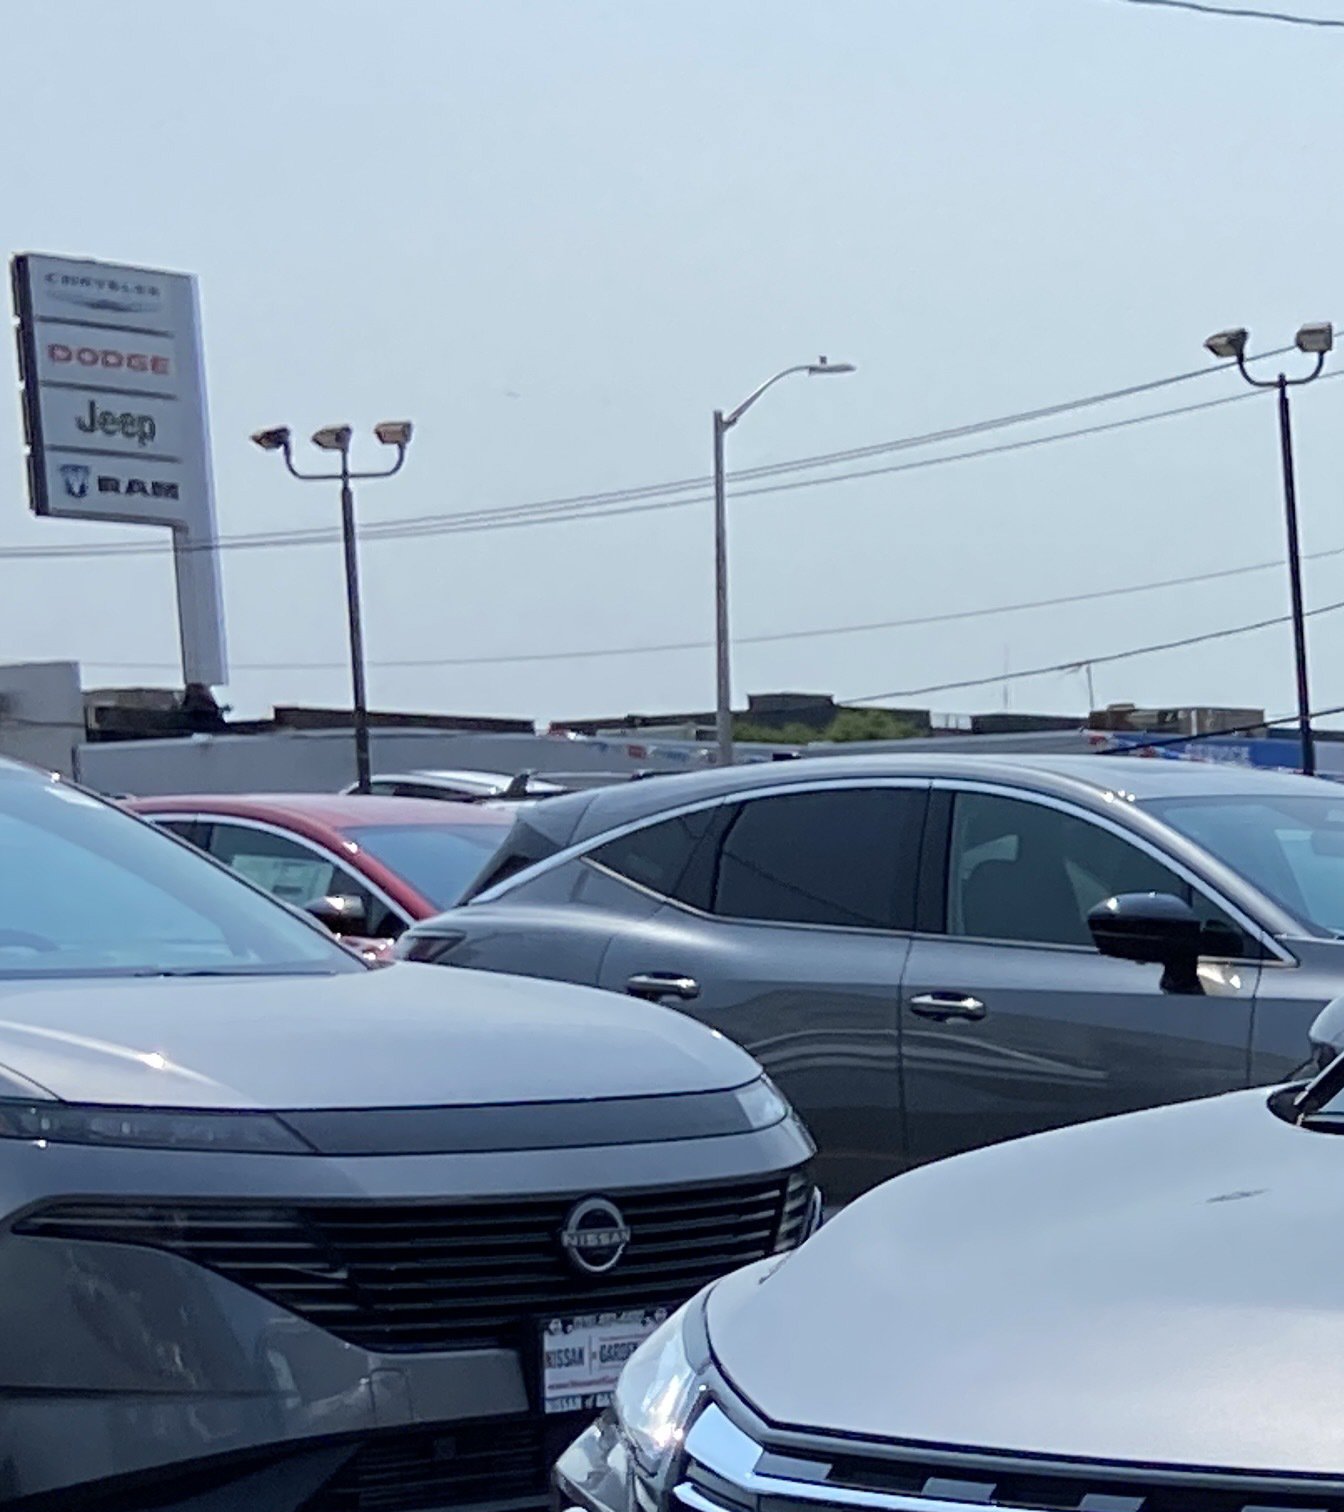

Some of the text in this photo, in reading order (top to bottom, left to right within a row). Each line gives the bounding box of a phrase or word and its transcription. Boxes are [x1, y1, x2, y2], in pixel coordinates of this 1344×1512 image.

[47, 343, 171, 375] DODGE
[75, 400, 156, 447] Jeep
[97, 474, 180, 501] RAM
[562, 1229, 630, 1248] NISSAN
